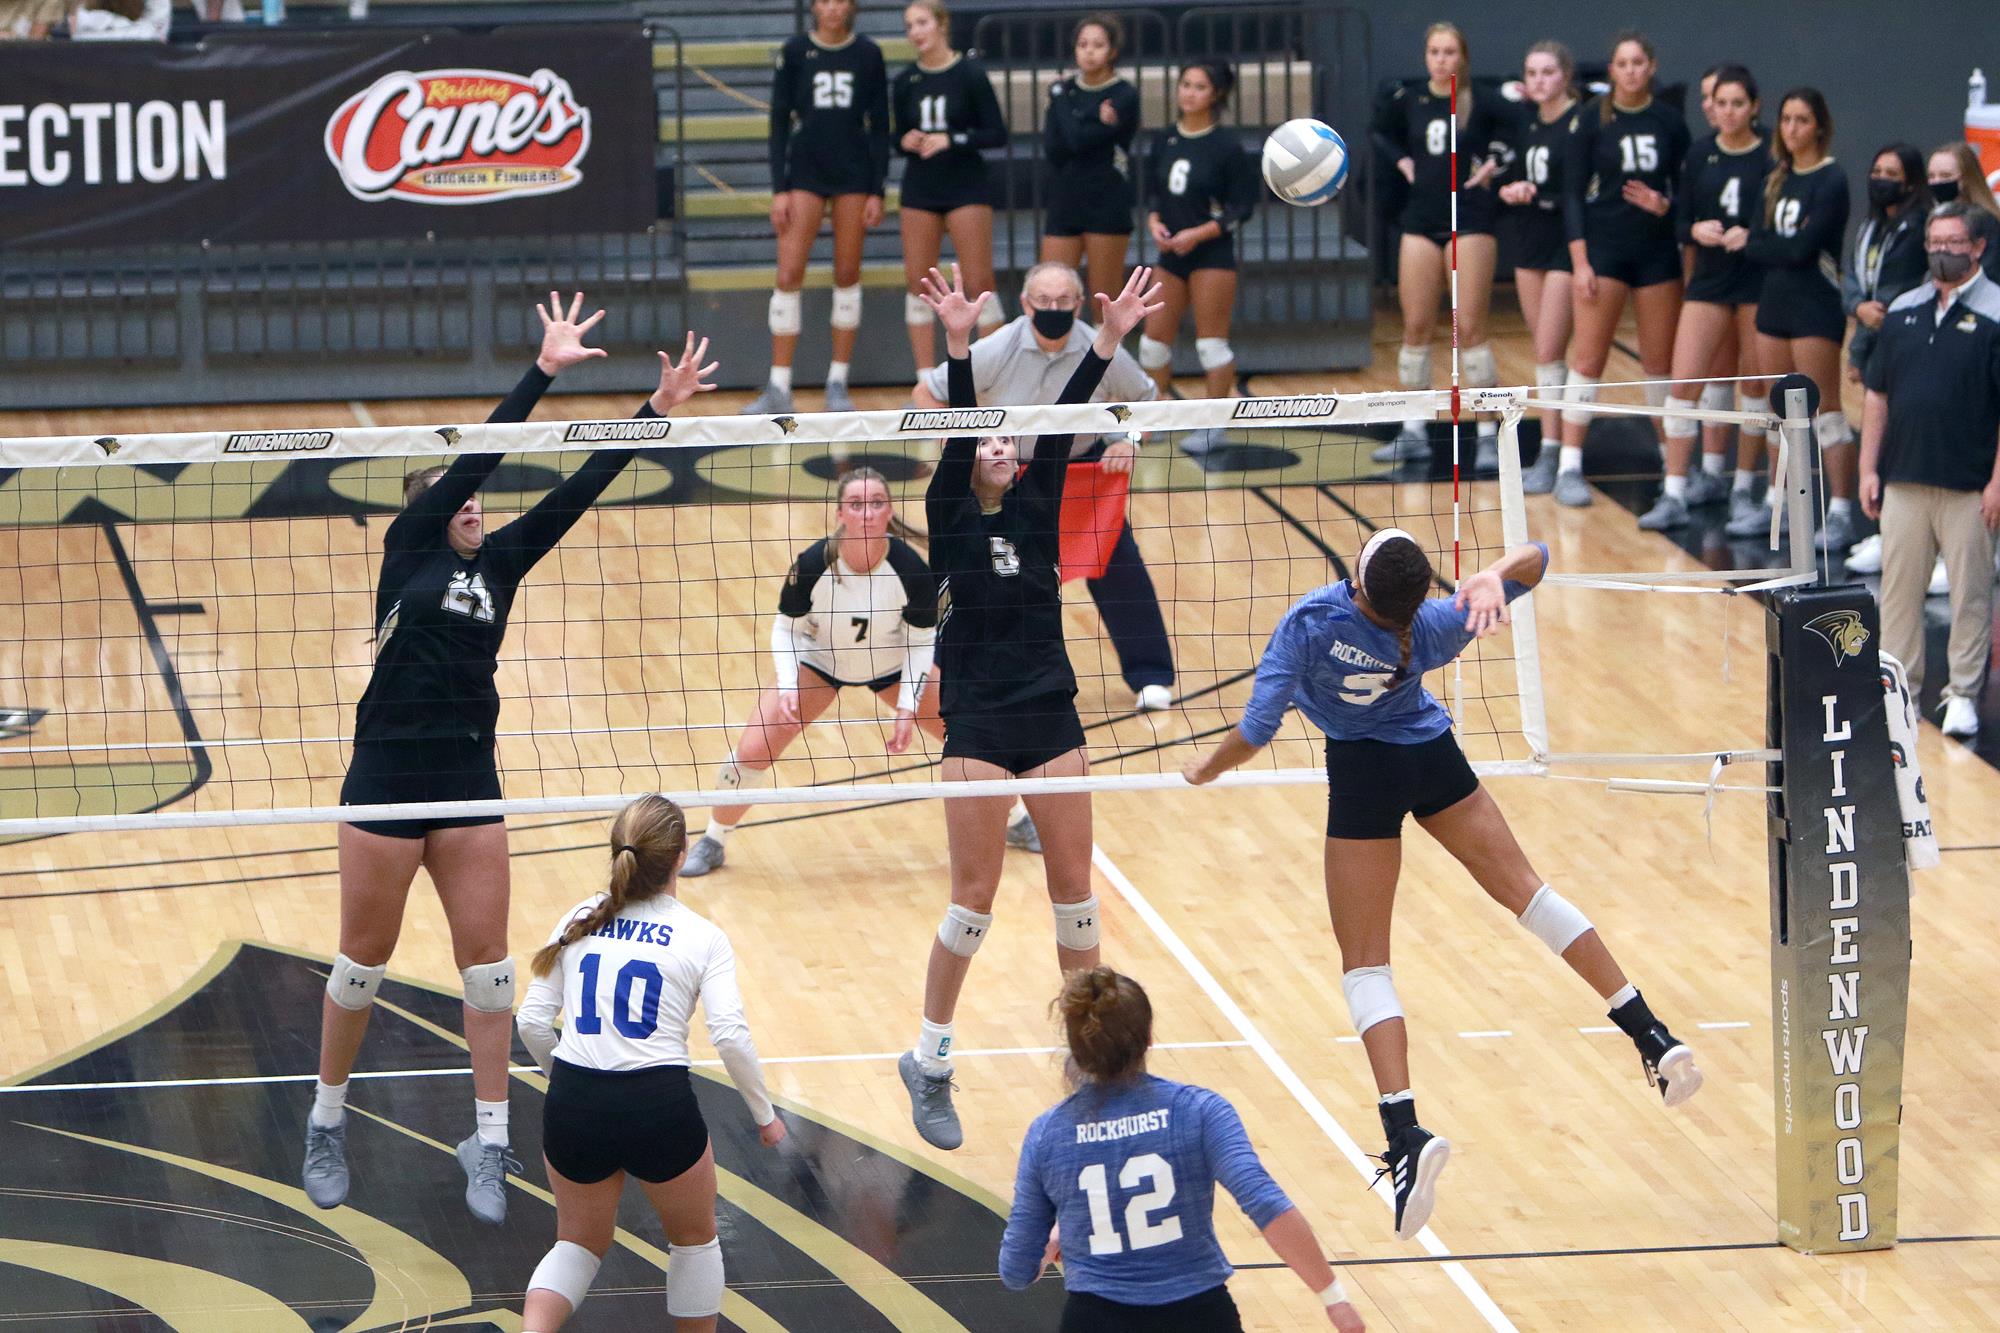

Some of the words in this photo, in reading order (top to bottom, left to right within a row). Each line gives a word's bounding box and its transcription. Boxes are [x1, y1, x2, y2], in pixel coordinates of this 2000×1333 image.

[426, 79, 511, 106] Raising
[812, 71, 853, 108] 25
[342, 69, 583, 190] Cane's
[920, 95, 947, 131] 11
[0, 100, 226, 187] ECTION
[1426, 119, 1447, 155] 8
[1620, 134, 1659, 172] 15
[1169, 158, 1190, 195] 6
[1525, 145, 1549, 184] 16
[1720, 176, 1740, 217] 4
[1775, 198, 1801, 238] 12
[901, 410, 1005, 431] LINDENWOOD
[1233, 398, 1338, 419] LINDENWOOD
[225, 432, 333, 453] LINDENWOOD
[564, 421, 671, 442] LINDENWOOD
[851, 616, 869, 643] 7
[588, 918, 674, 947] AWKS
[1821, 694, 1869, 1242] LINDENWOOD
[575, 952, 663, 1040] 10
[1781, 978, 1790, 1047] sports
[1783, 1050, 1793, 1136] imports
[1076, 1108, 1169, 1144] ROCKHURST
[1078, 1152, 1184, 1256] 12
